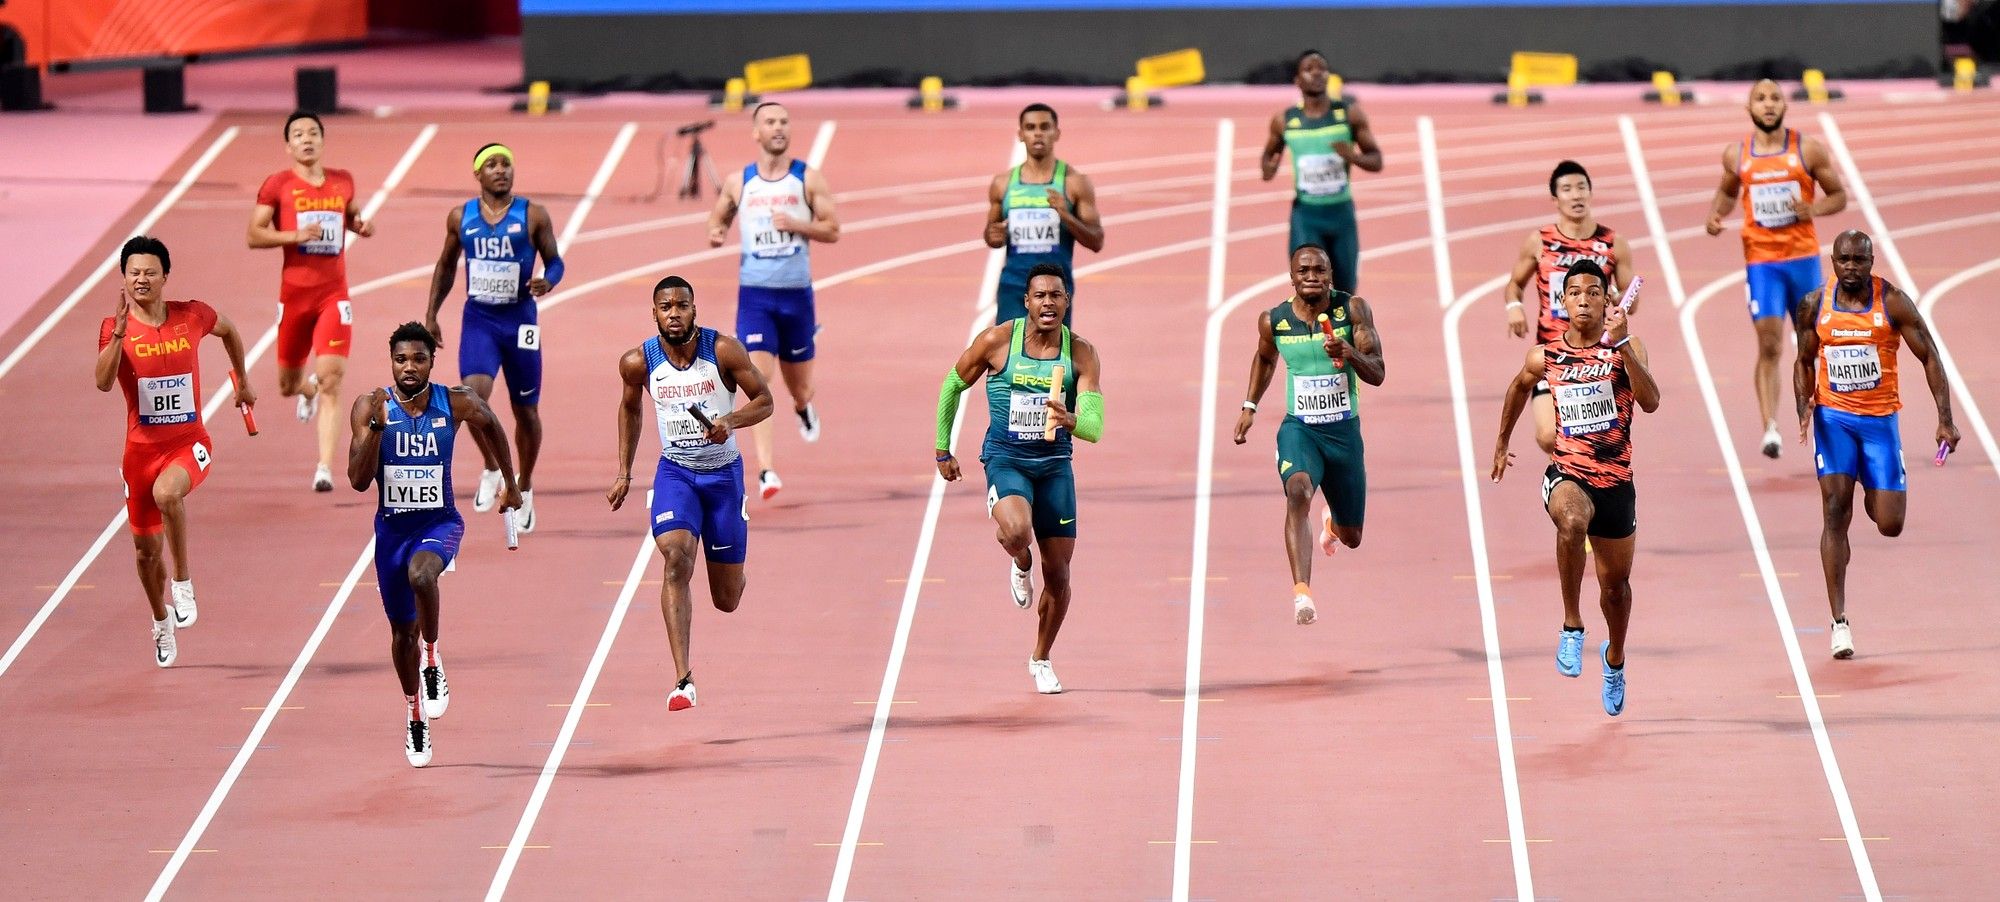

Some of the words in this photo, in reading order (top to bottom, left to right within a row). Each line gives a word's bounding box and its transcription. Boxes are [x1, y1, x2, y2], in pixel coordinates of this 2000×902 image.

[295, 196, 345, 212] CHINA
[755, 230, 796, 246] KILTY
[1013, 226, 1055, 241] SILVA
[474, 236, 514, 259] USA
[471, 277, 516, 294] RODGERS
[525, 329, 535, 346] 8
[134, 337, 191, 358] CHINA
[1839, 348, 1869, 359] TDK
[1557, 362, 1614, 381] JAPAN
[1829, 361, 1879, 379] MARTINA
[159, 377, 186, 390] TDK
[657, 385, 682, 399] GREAT
[683, 379, 715, 398] BRITAIN
[1310, 377, 1341, 388] TDK
[1572, 384, 1603, 397] TDK
[154, 394, 181, 412] BIE
[1031, 396, 1049, 406] TD
[1297, 391, 1347, 410] SIMBINE
[1560, 404, 1580, 422] SANI
[1581, 398, 1614, 420] BROWN
[149, 414, 188, 424] DOHA2019
[1011, 410, 1032, 427] CAMILO
[1033, 411, 1041, 427] DE
[1303, 412, 1344, 425] DOHA2019
[1018, 432, 1045, 440] DOHA2
[1569, 421, 1610, 436] DOHA2019
[395, 431, 439, 457] USA
[403, 469, 436, 479] TDK
[388, 485, 438, 503] LYLES
